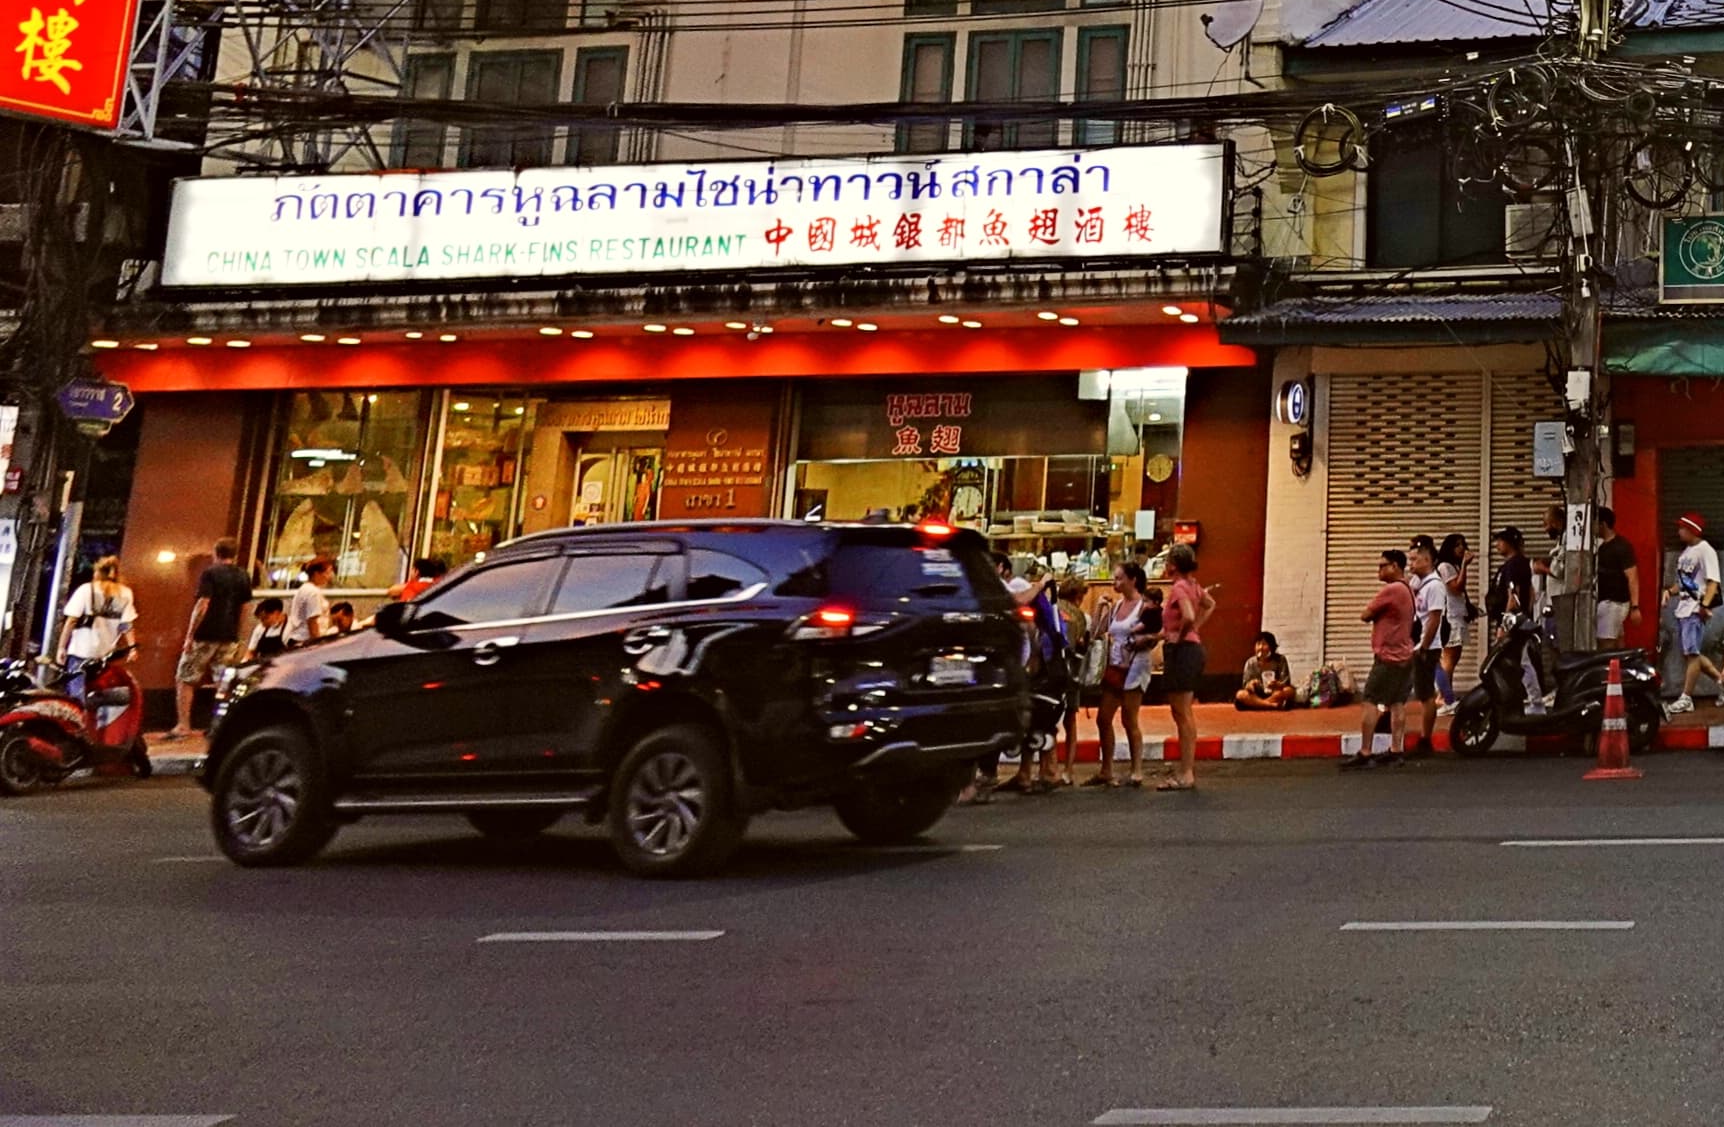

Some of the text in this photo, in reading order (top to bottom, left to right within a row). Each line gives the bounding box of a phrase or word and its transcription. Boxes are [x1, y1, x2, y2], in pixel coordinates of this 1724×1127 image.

[764, 203, 1155, 257] 中國城銀都魚翅酒樓
[207, 234, 747, 272] CHINA TOWN SCALA SHARK-FINS RESTAURANT
[112, 392, 124, 411] 2
[886, 393, 972, 427] หูฉลาม
[892, 425, 961, 455] 魚翅
